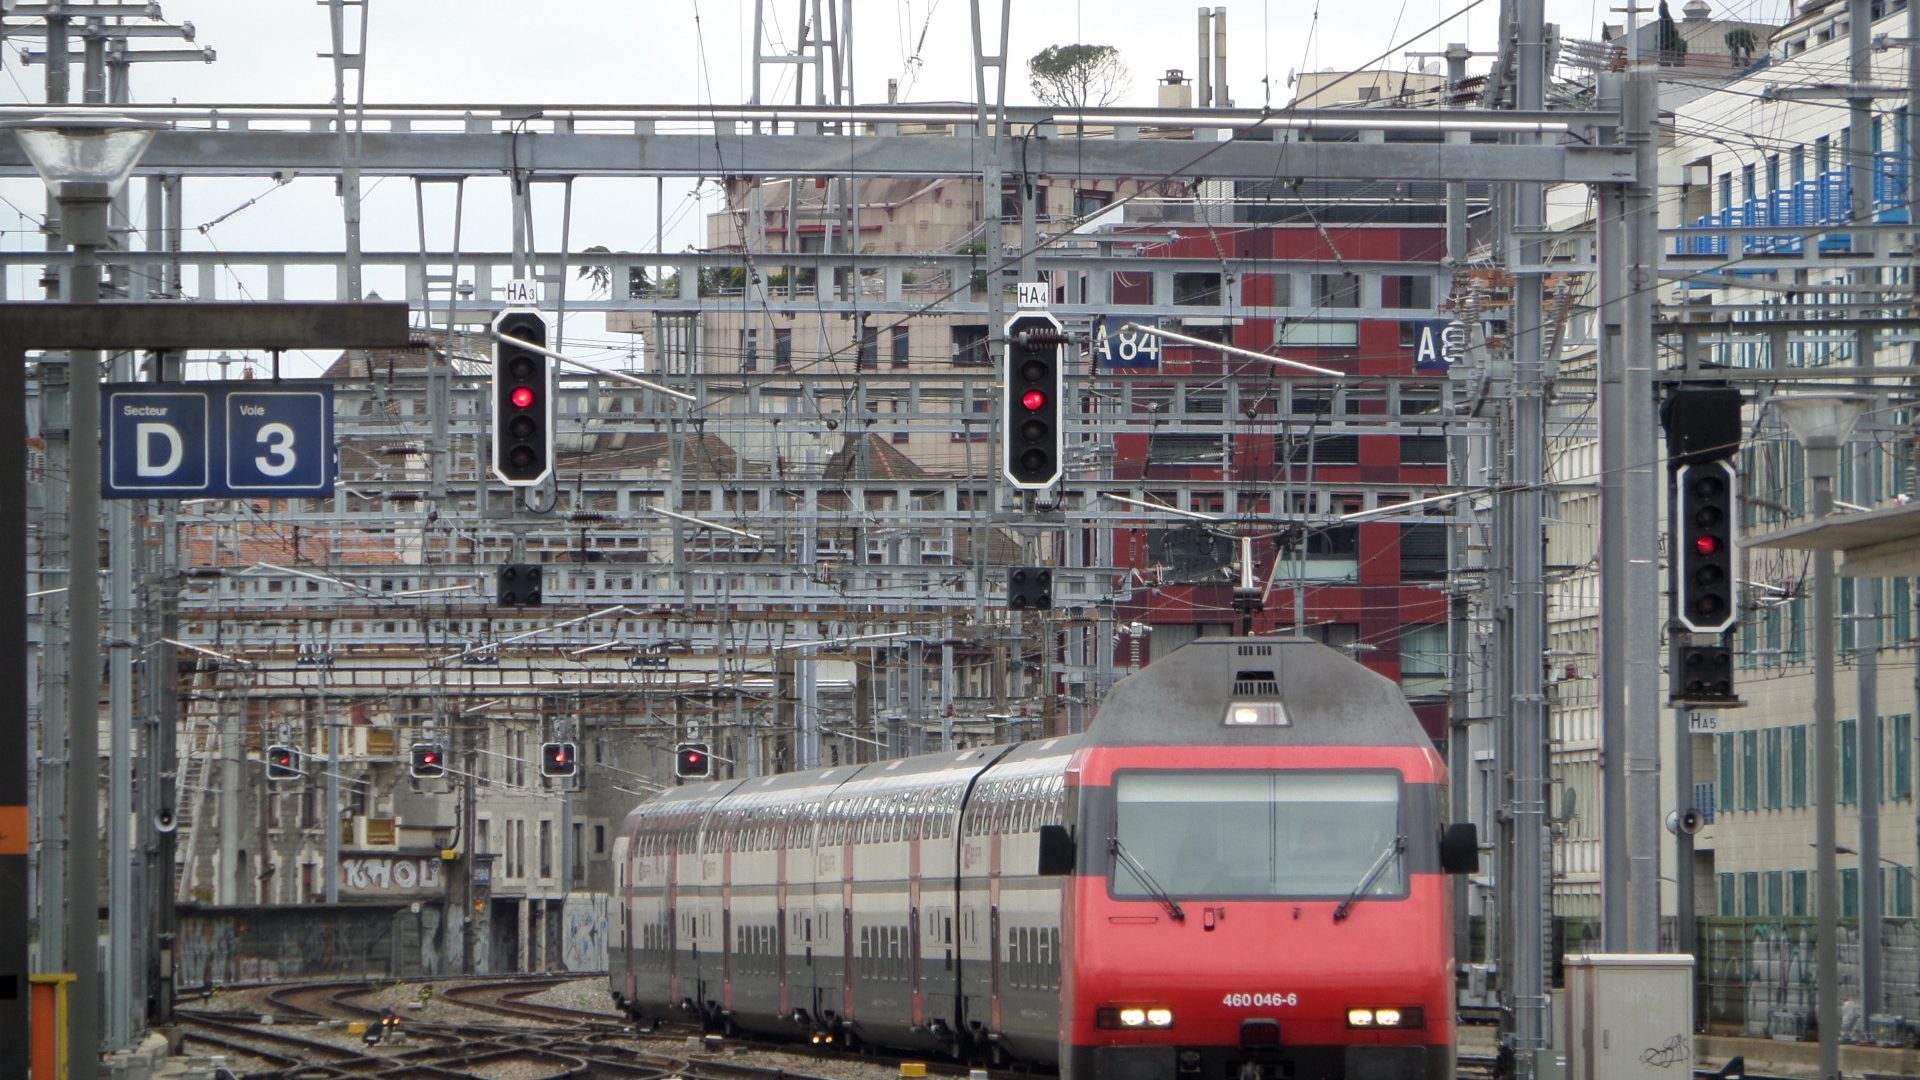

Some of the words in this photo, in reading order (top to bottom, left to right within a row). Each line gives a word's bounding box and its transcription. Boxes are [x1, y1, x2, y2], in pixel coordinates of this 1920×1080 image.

[507, 283, 535, 300] HA3
[1019, 286, 1046, 304] HA4
[1097, 325, 1112, 361] A
[1119, 325, 1159, 361] 84
[1417, 326, 1436, 361] A
[123, 405, 168, 416] Secteur
[239, 405, 265, 416] Voie
[136, 422, 183, 477] D
[255, 422, 296, 477] 3
[1222, 993, 1251, 1007] 460
[1253, 993, 1297, 1007] 046-6
